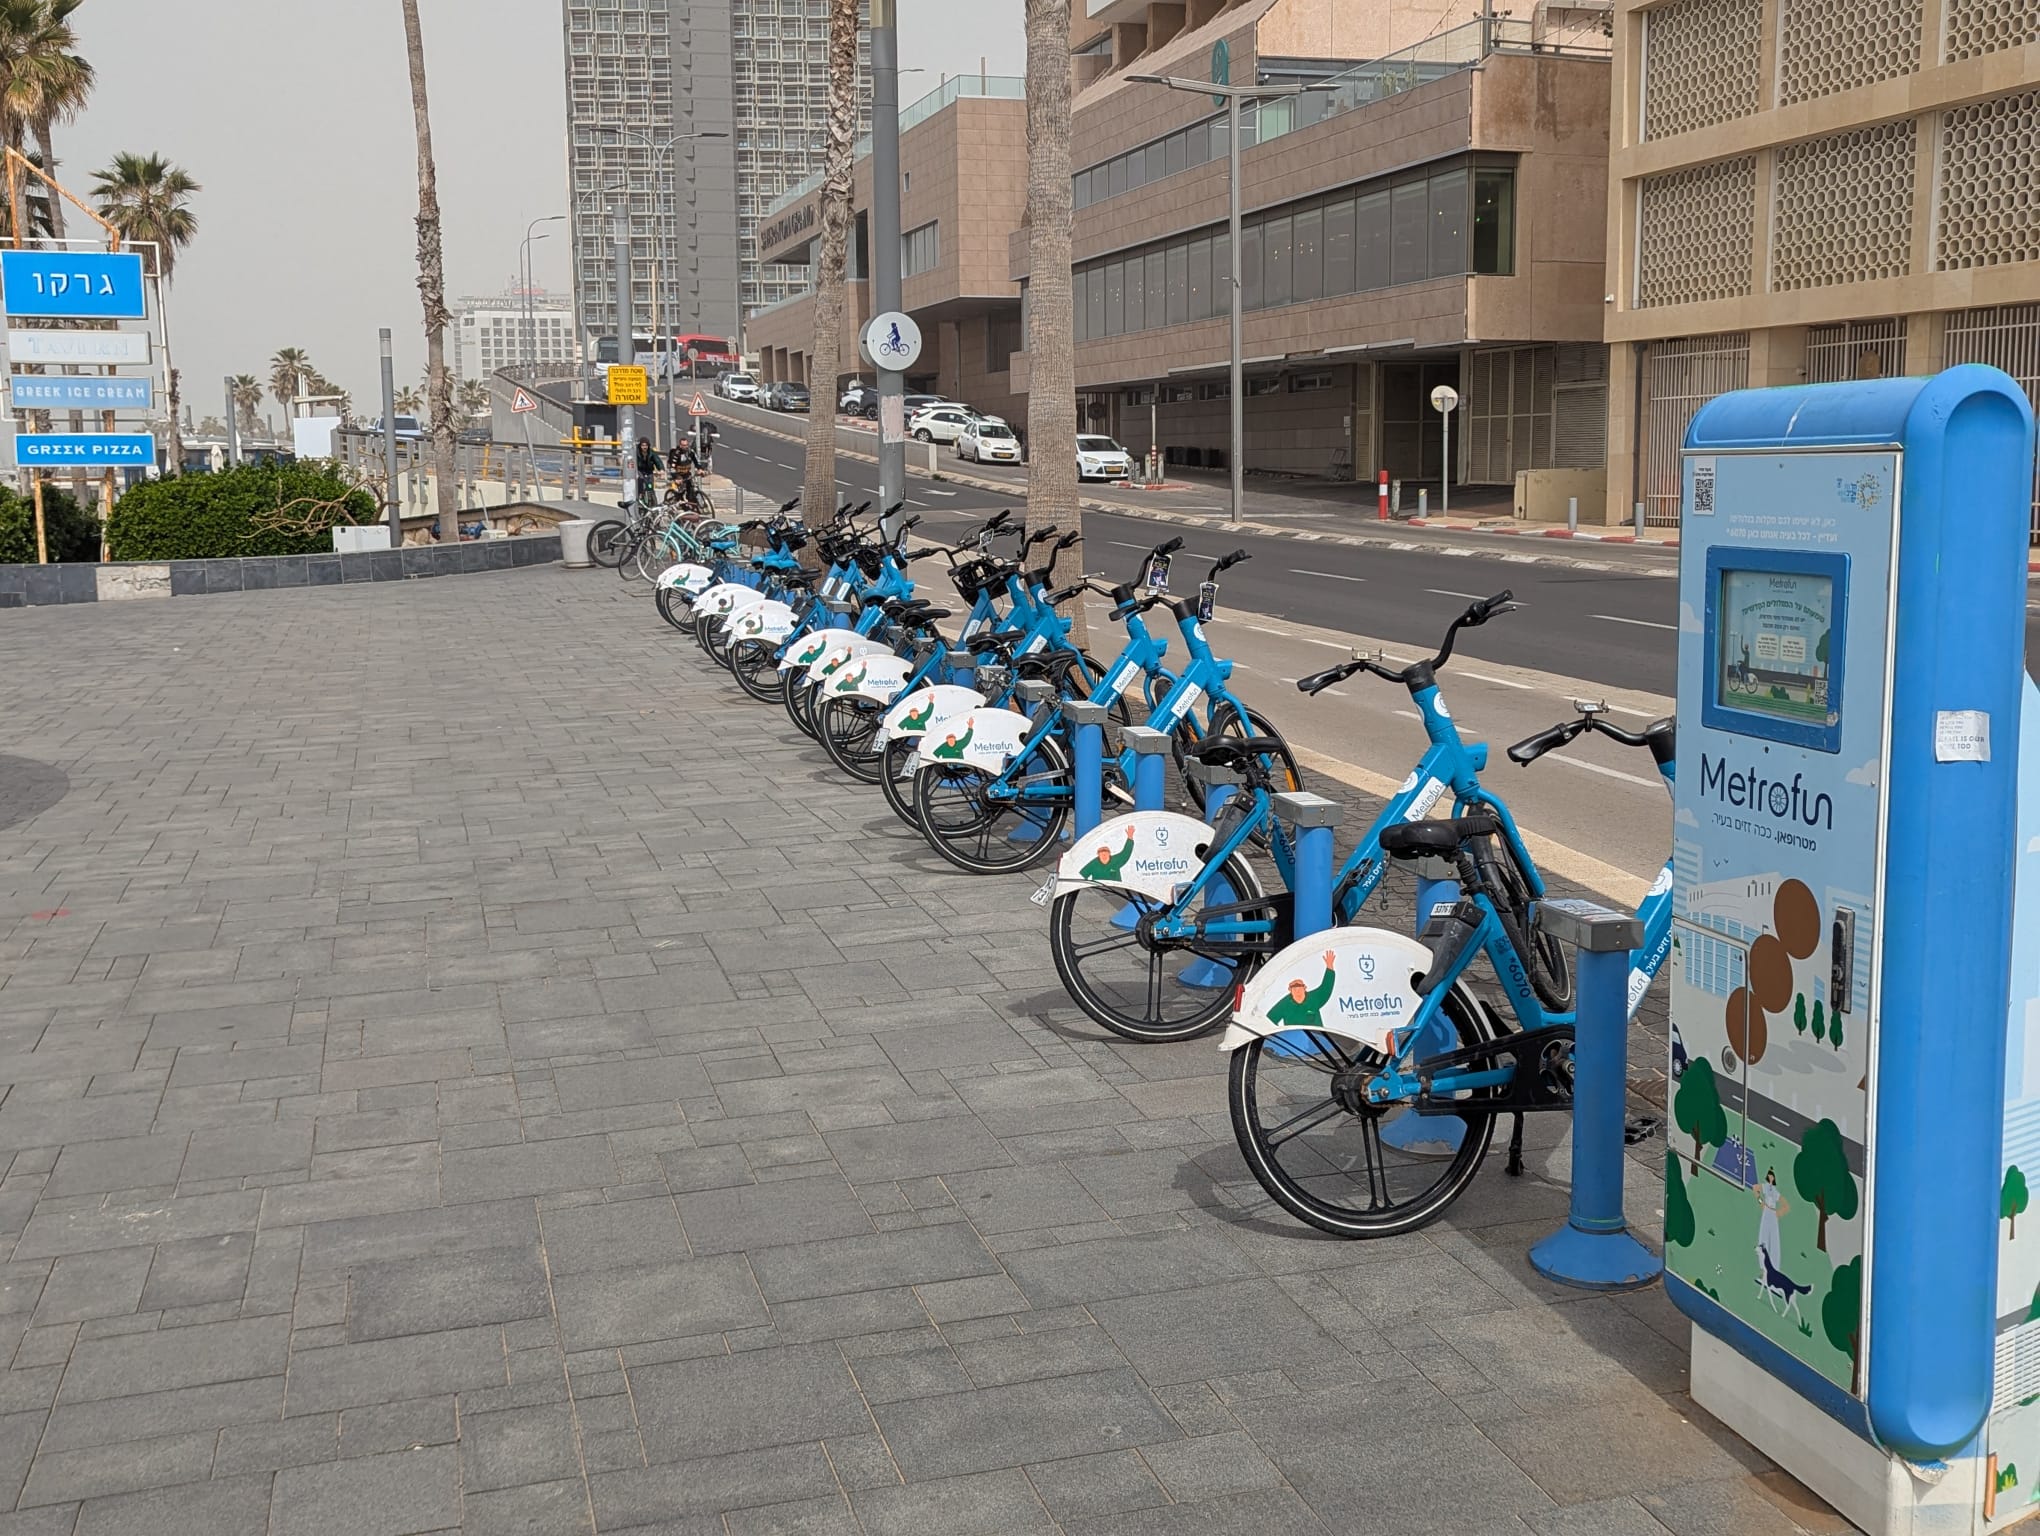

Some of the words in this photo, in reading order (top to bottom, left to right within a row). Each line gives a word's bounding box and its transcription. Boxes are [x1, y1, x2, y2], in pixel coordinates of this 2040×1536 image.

[32, 272, 114, 297] גרקו
[16, 386, 61, 397] GREEK
[92, 445, 143, 455] PIZZA
[974, 742, 1014, 752] Metrofun
[1700, 752, 1833, 830] Metrofun
[1411, 784, 1442, 820] Metrofun
[1712, 812, 1732, 828] בעיר.
[1734, 819, 1751, 833] זזים
[1754, 824, 1772, 838] ככה
[1775, 830, 1817, 851] מטרופאן.
[1136, 857, 1188, 872] Metrofun
[1339, 992, 1403, 1013] Metrofun
